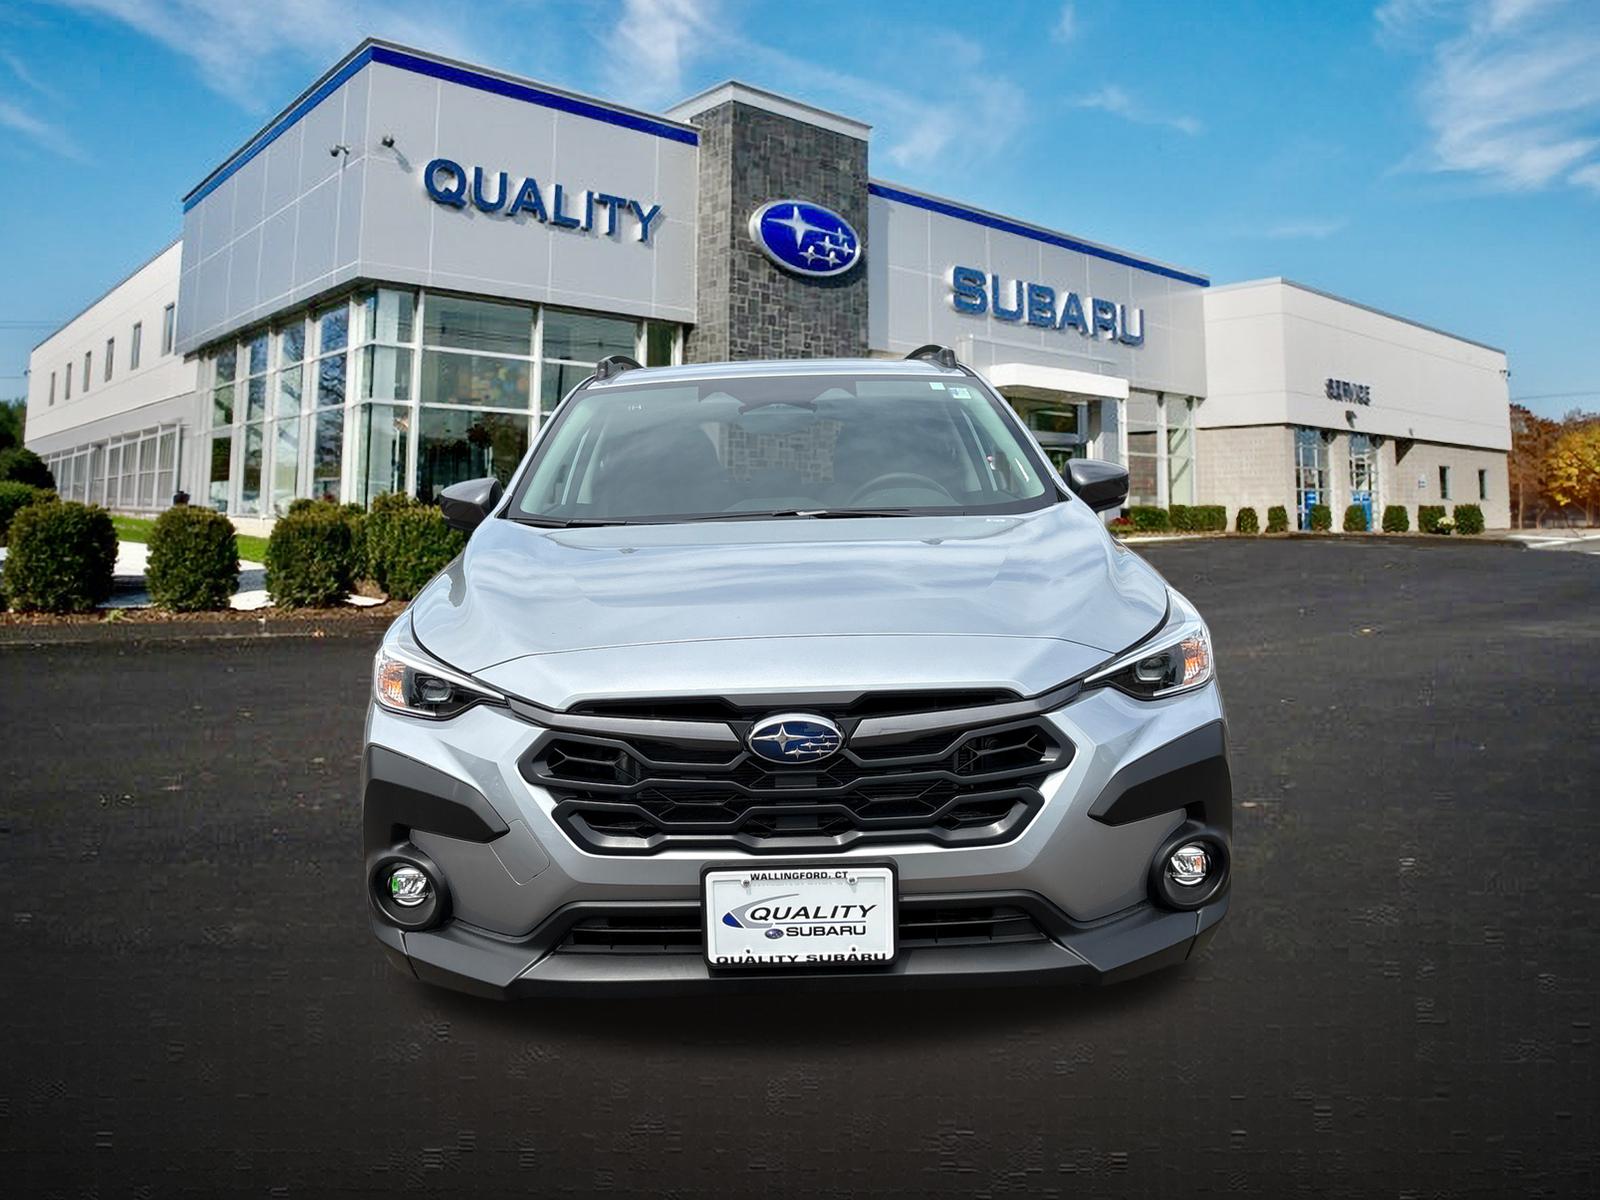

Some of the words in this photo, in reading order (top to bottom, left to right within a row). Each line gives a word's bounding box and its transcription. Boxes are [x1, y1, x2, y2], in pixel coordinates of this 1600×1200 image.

[423, 157, 662, 244] QUALITY
[949, 265, 1145, 347] SUBARU
[835, 870, 849, 880] CT
[750, 904, 877, 921] QUALITY
[785, 925, 867, 937] SUBARU
[716, 954, 799, 965] QUALITY
[806, 952, 887, 963] SUBARU
